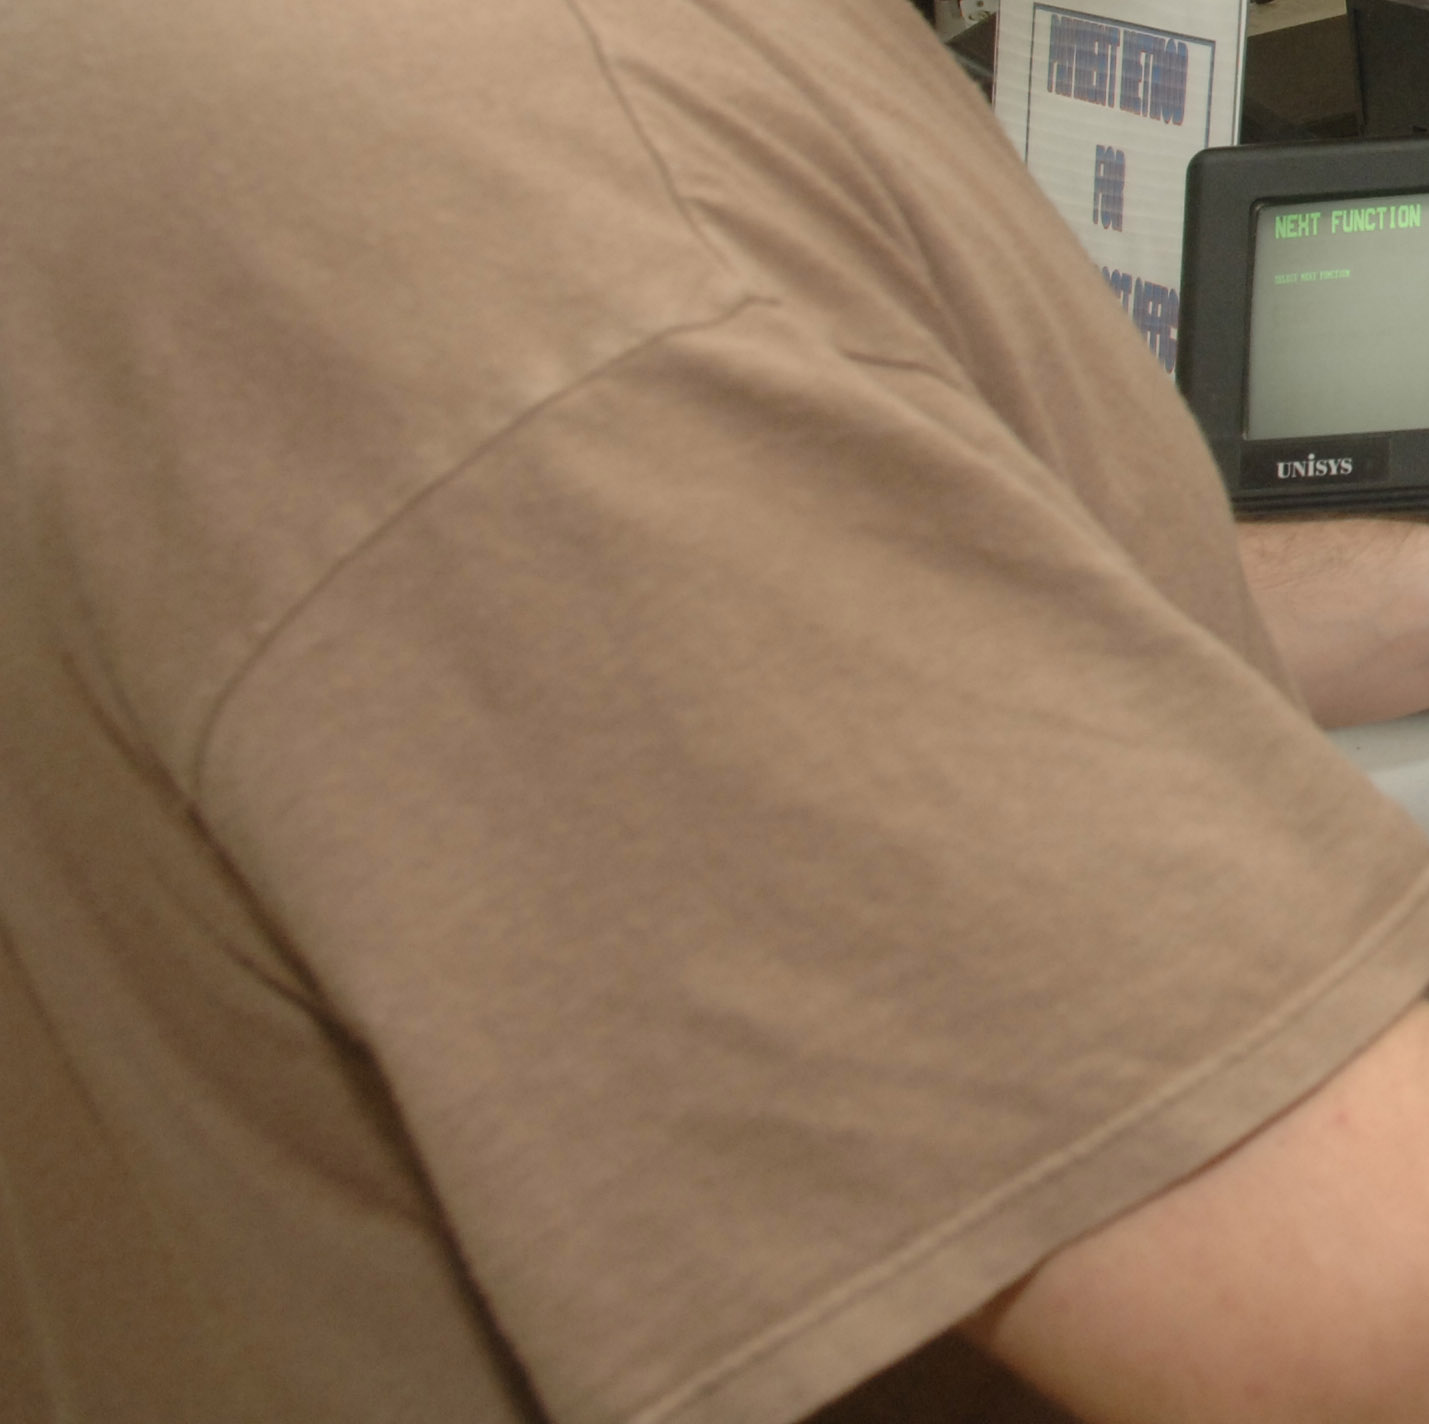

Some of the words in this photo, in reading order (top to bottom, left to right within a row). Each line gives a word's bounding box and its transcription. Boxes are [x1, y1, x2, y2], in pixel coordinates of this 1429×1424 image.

[1047, 13, 1120, 107] PAYMENT
[1093, 144, 1127, 232] FOR
[1275, 212, 1321, 239] NEXT
[1331, 204, 1422, 234] FUNCTION
